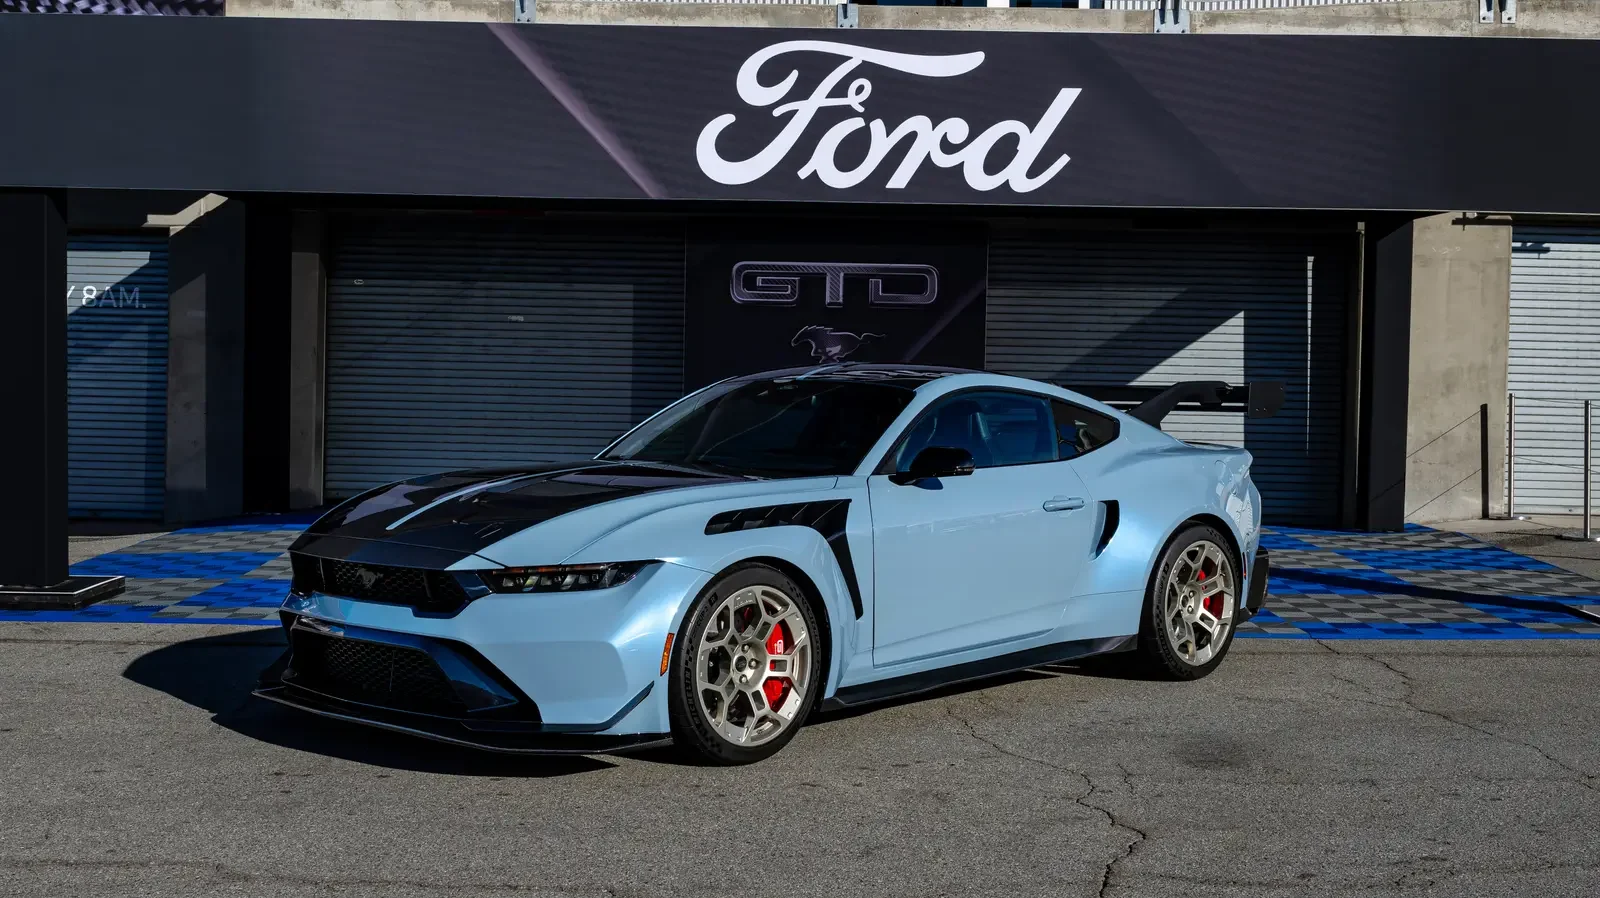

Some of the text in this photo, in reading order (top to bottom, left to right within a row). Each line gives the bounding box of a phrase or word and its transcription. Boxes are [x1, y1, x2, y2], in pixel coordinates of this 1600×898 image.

[696, 40, 1082, 193] Ford
[82, 285, 147, 309] 8AM.
[730, 261, 938, 306] GTD
